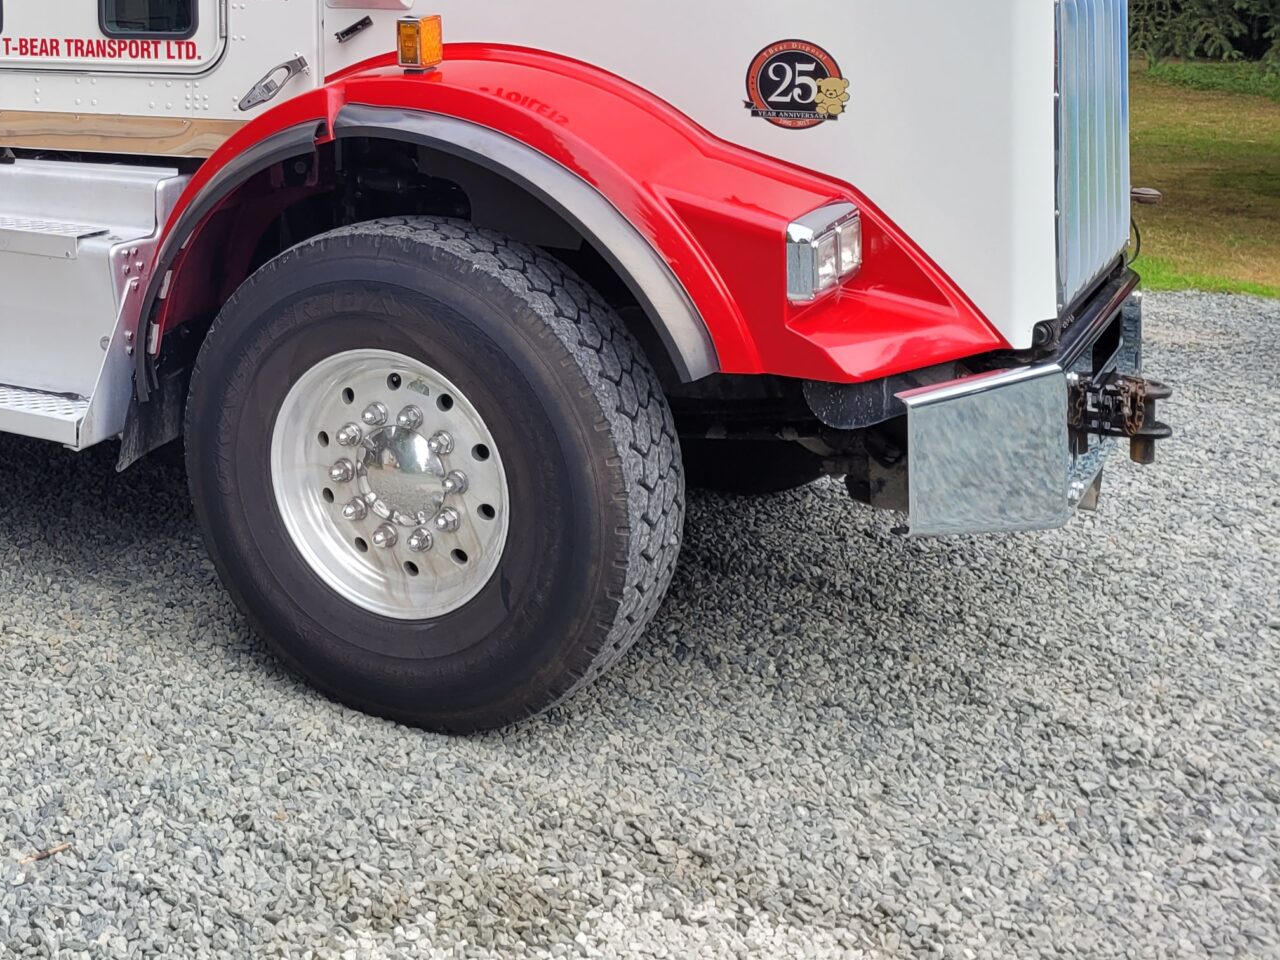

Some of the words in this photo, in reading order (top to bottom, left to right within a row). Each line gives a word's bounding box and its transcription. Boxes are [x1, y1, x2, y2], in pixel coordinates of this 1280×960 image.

[2, 37, 60, 57] T-BEAR
[65, 38, 162, 59] TRANSPORT
[166, 39, 202, 61] LTD.
[792, 43, 828, 60] Disposal
[768, 62, 818, 103] 25
[779, 112, 829, 120] ANNIVERSARY
